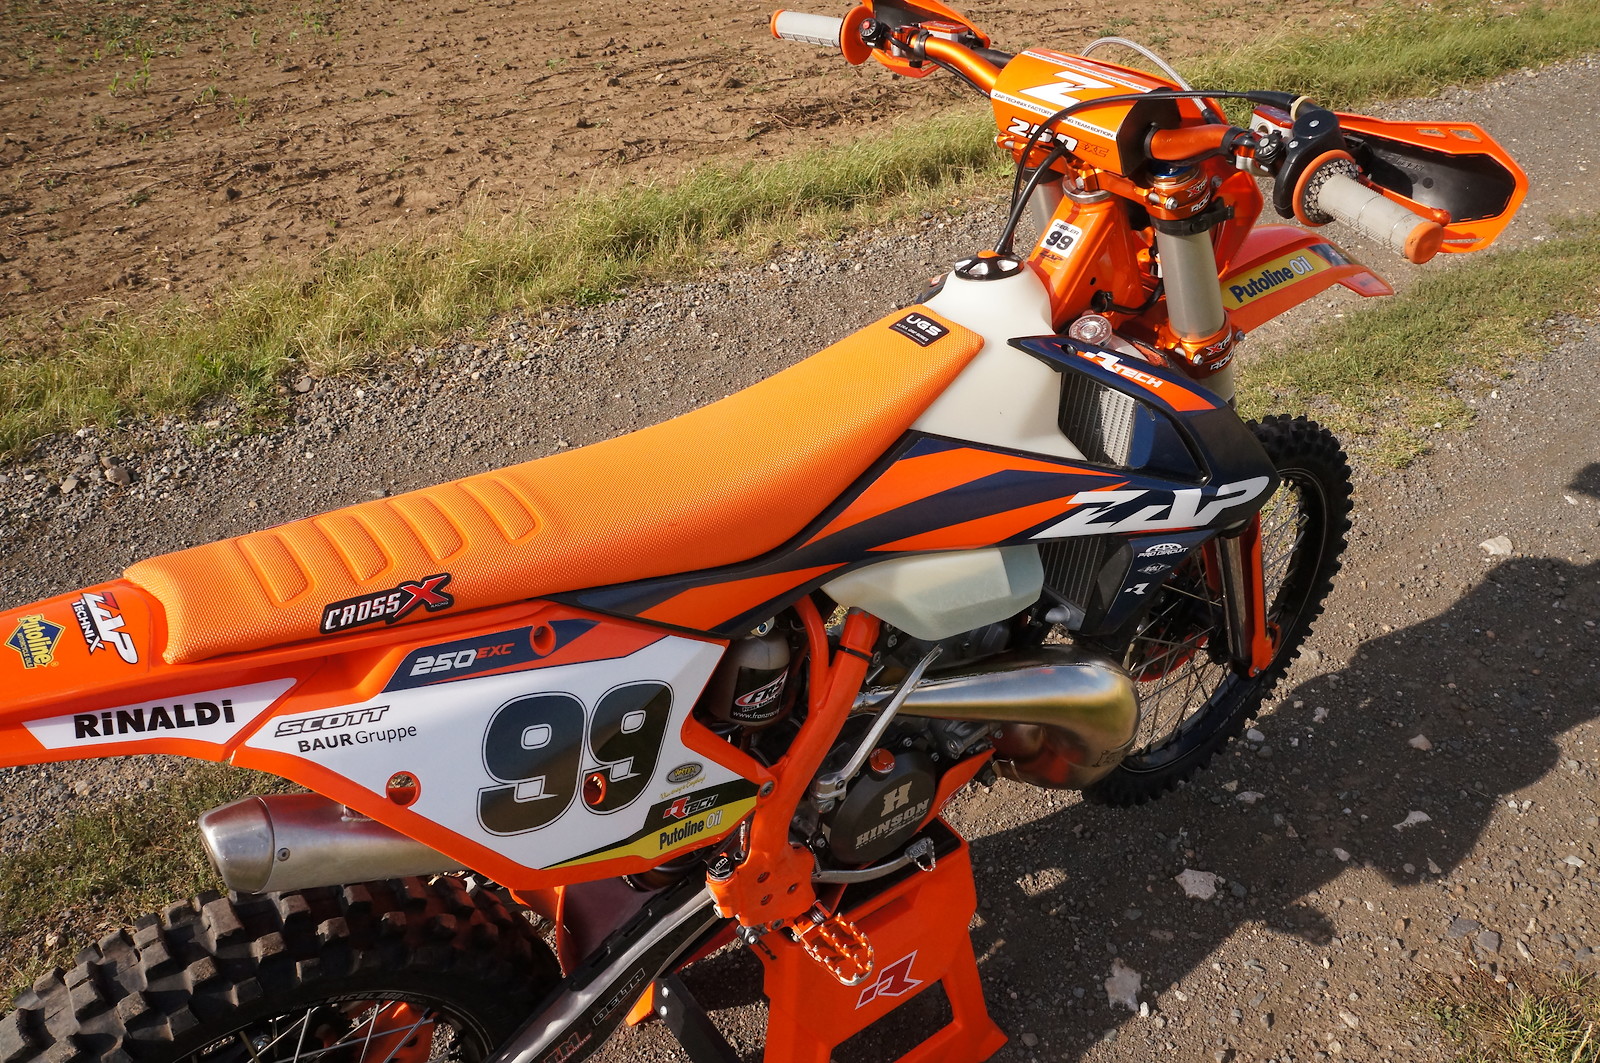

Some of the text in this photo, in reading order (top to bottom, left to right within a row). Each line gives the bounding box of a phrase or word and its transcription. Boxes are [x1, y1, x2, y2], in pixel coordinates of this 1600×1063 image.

[1045, 230, 1074, 250] 99
[1229, 255, 1314, 303] Putoline Oil
[906, 315, 942, 337] UGS
[1028, 475, 1270, 540] ZAP
[1156, 547, 1189, 556] CIRCUIT
[18, 613, 52, 665] Putoline
[72, 599, 105, 654] TECHNIX
[82, 591, 138, 664] ZAP
[409, 642, 515, 677] 250 EXC
[274, 705, 391, 738] SCOTT
[297, 725, 418, 753] BAUR Gruppe
[476, 679, 675, 837] 99
[880, 781, 913, 818] H
[660, 809, 723, 850] Putoline Oil
[856, 798, 930, 847] HINSON
